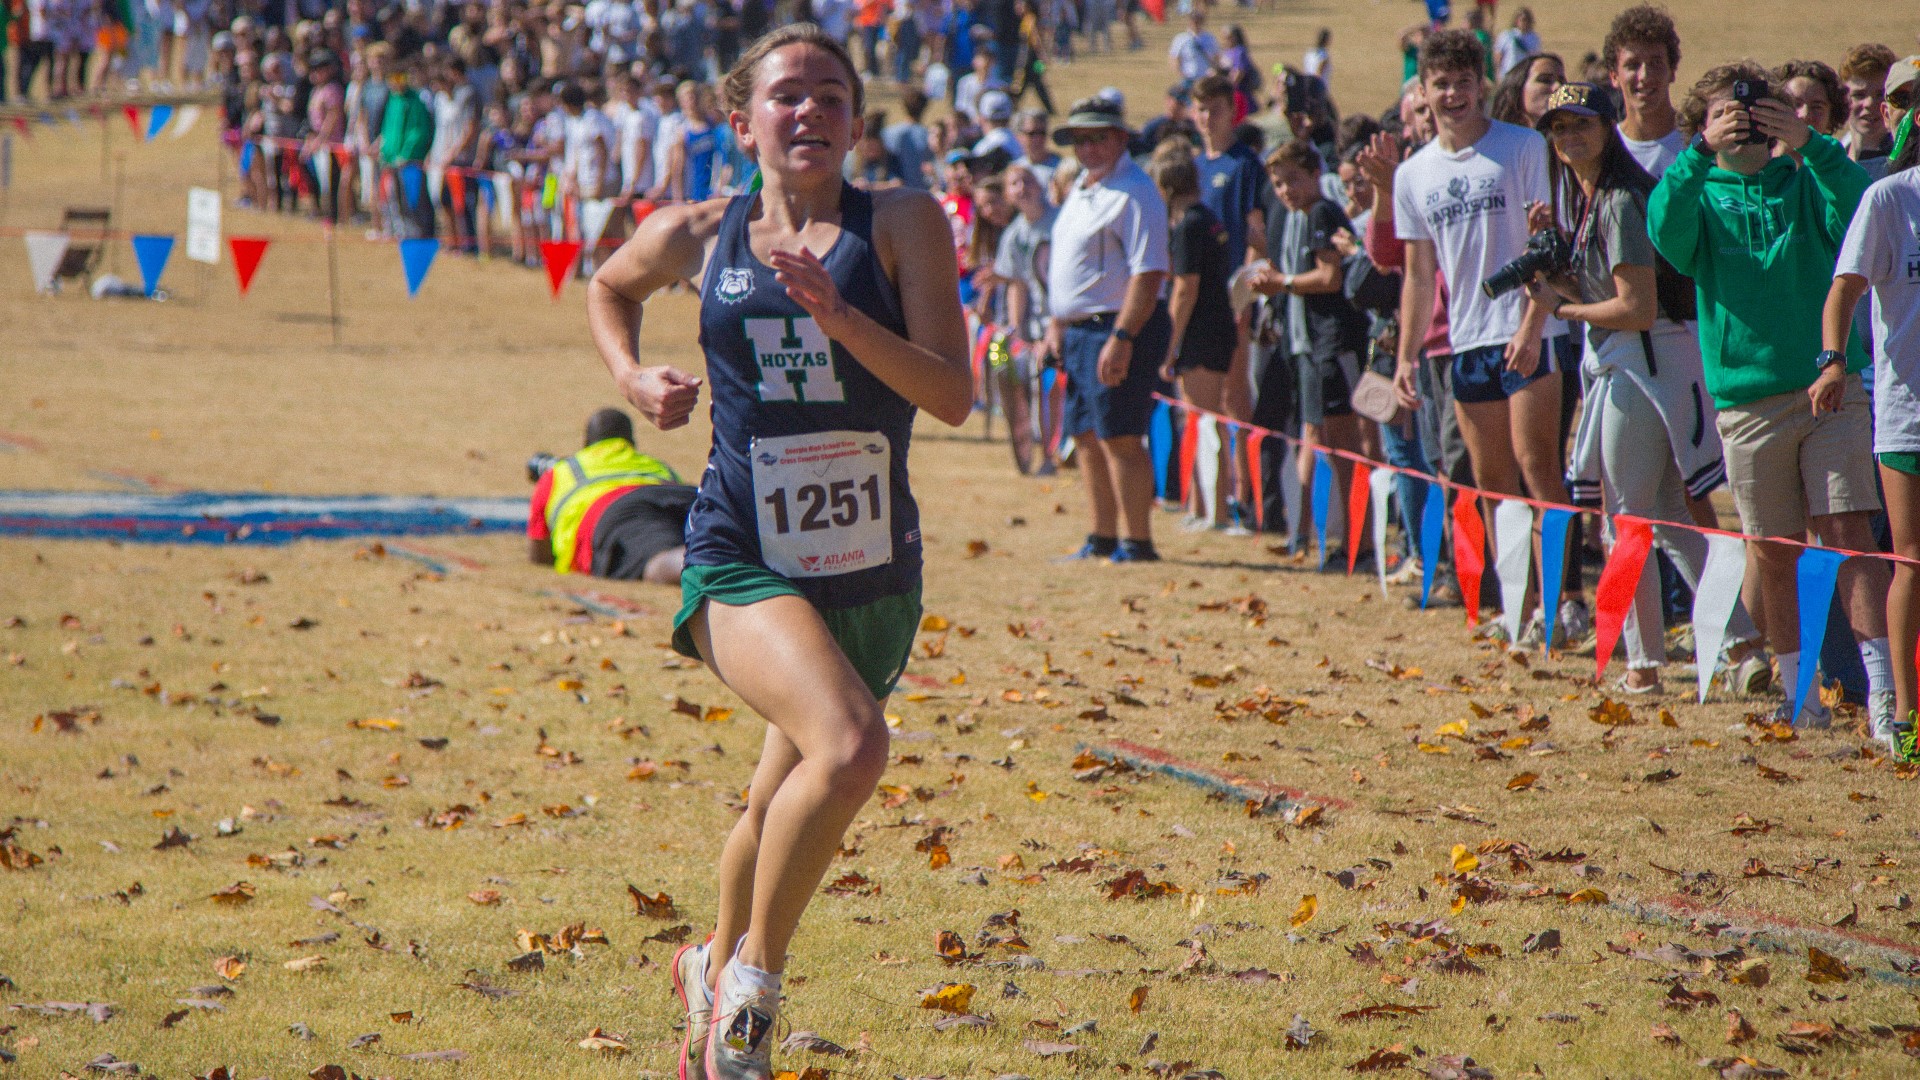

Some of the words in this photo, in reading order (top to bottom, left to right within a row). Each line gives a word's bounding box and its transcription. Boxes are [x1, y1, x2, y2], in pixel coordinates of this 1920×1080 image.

[760, 352, 828, 368] HOYAS
[764, 474, 881, 535] 1251
[824, 549, 865, 566] ATLANTA
